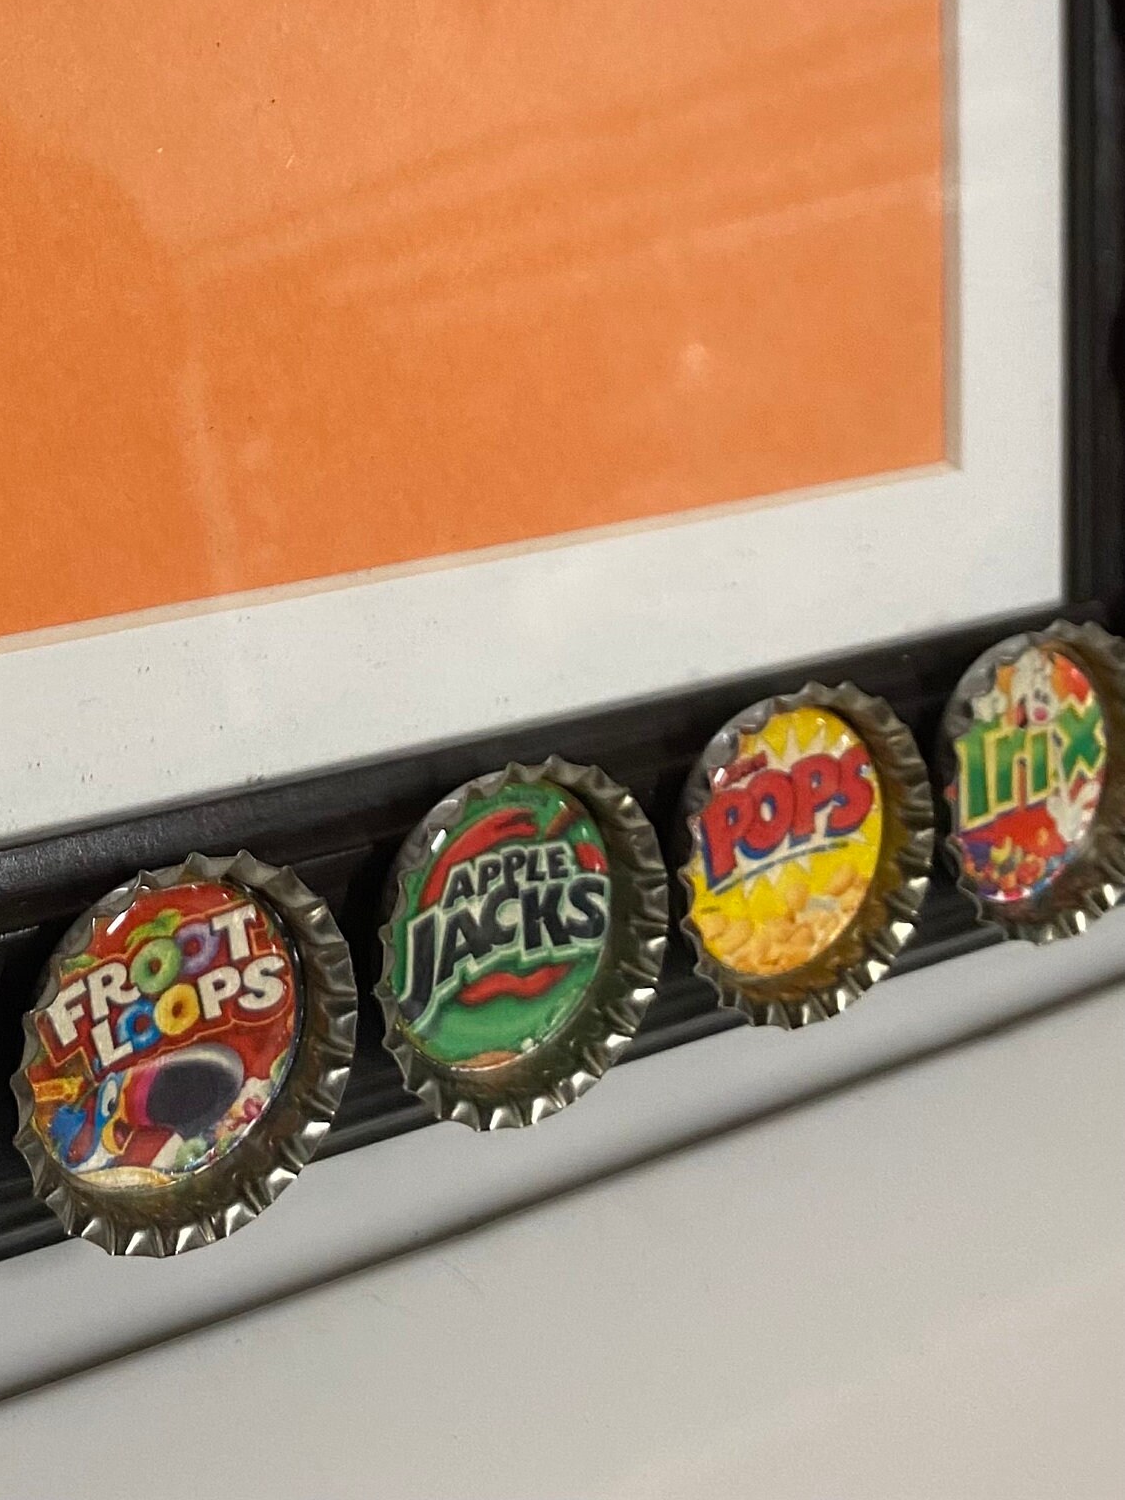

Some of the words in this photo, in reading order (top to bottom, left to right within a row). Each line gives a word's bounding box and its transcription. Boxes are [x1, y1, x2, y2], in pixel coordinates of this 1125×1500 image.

[445, 843, 572, 909] APPLE
[701, 744, 875, 891] POPS
[46, 903, 258, 1047] FROOT
[90, 953, 286, 1067] LOOPS
[398, 874, 610, 1025] JACKS
